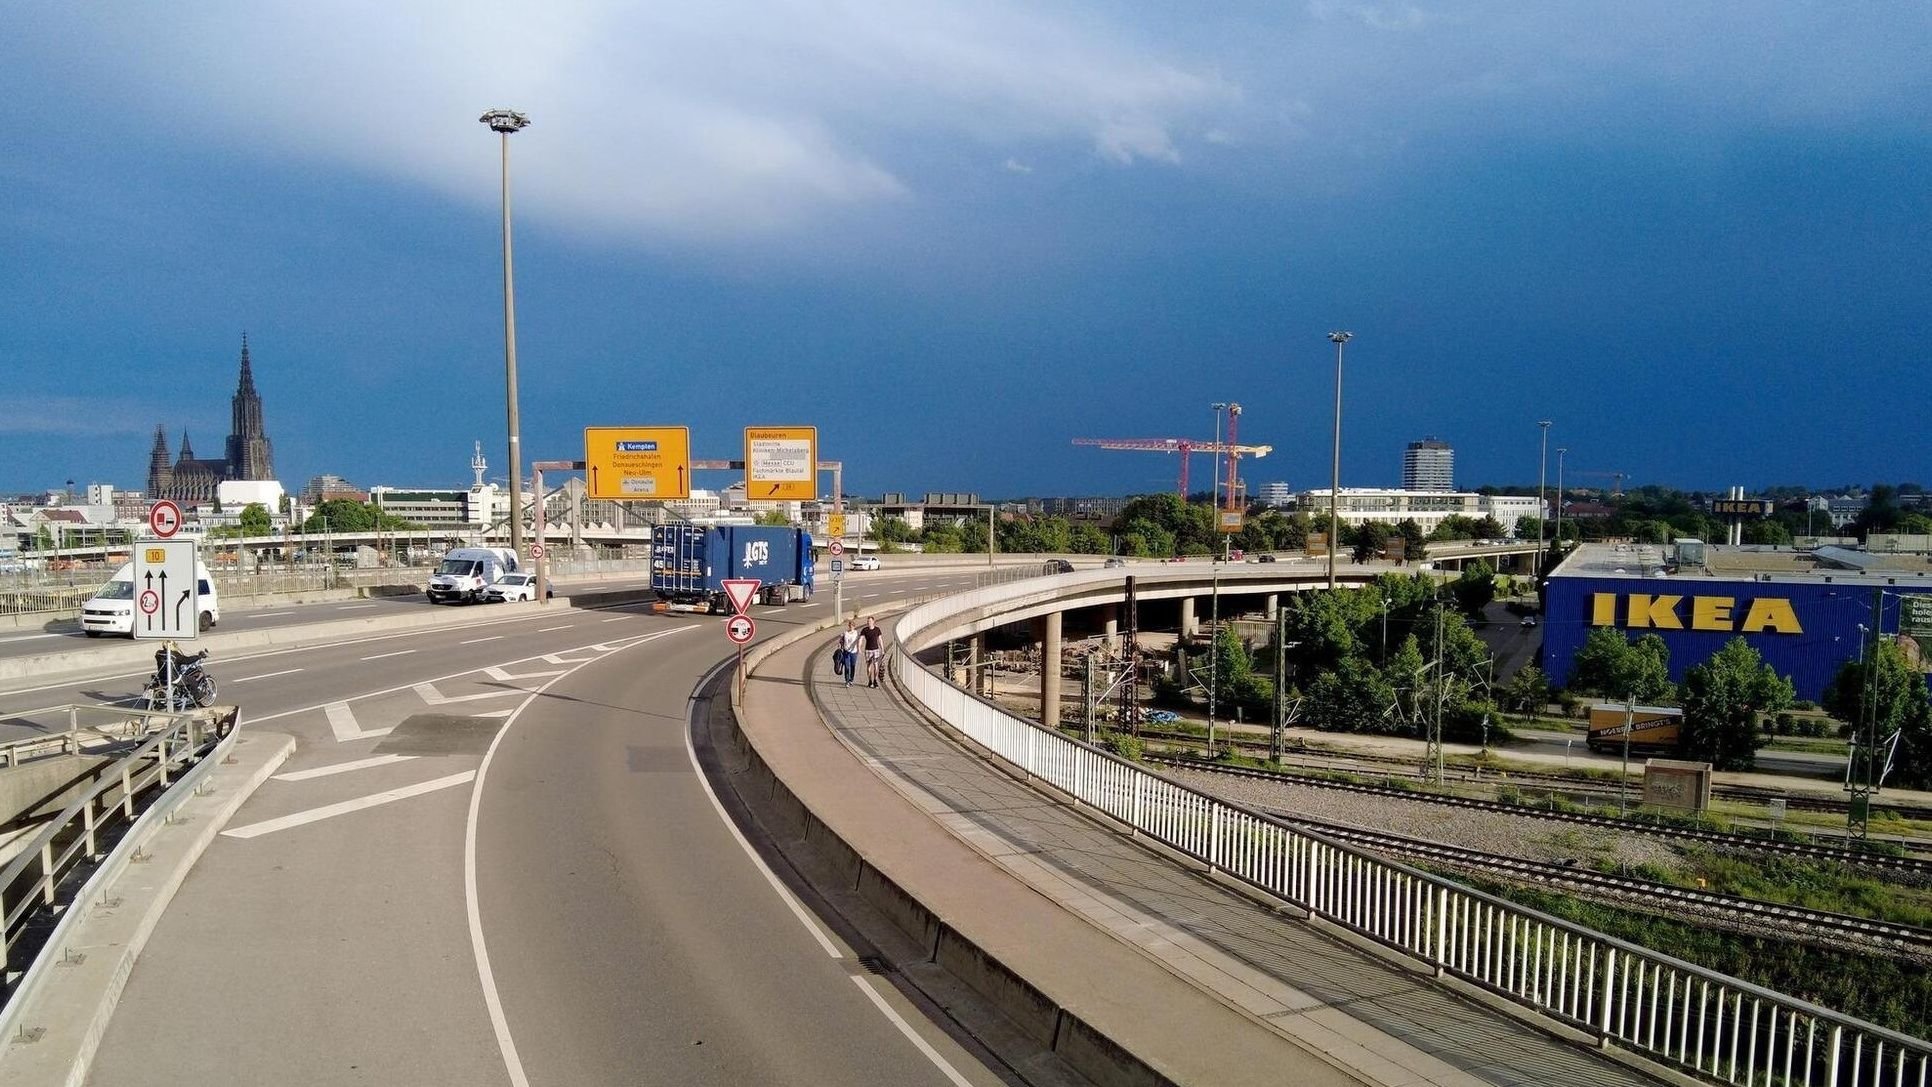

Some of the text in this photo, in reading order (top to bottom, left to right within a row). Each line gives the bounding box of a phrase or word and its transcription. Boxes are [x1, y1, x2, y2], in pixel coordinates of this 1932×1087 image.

[627, 443, 656, 451] Kempten
[612, 461, 663, 469] Donaueschingen
[1714, 502, 1761, 513] IKEA
[151, 551, 161, 561] 10
[1592, 592, 1804, 634] IKEA
